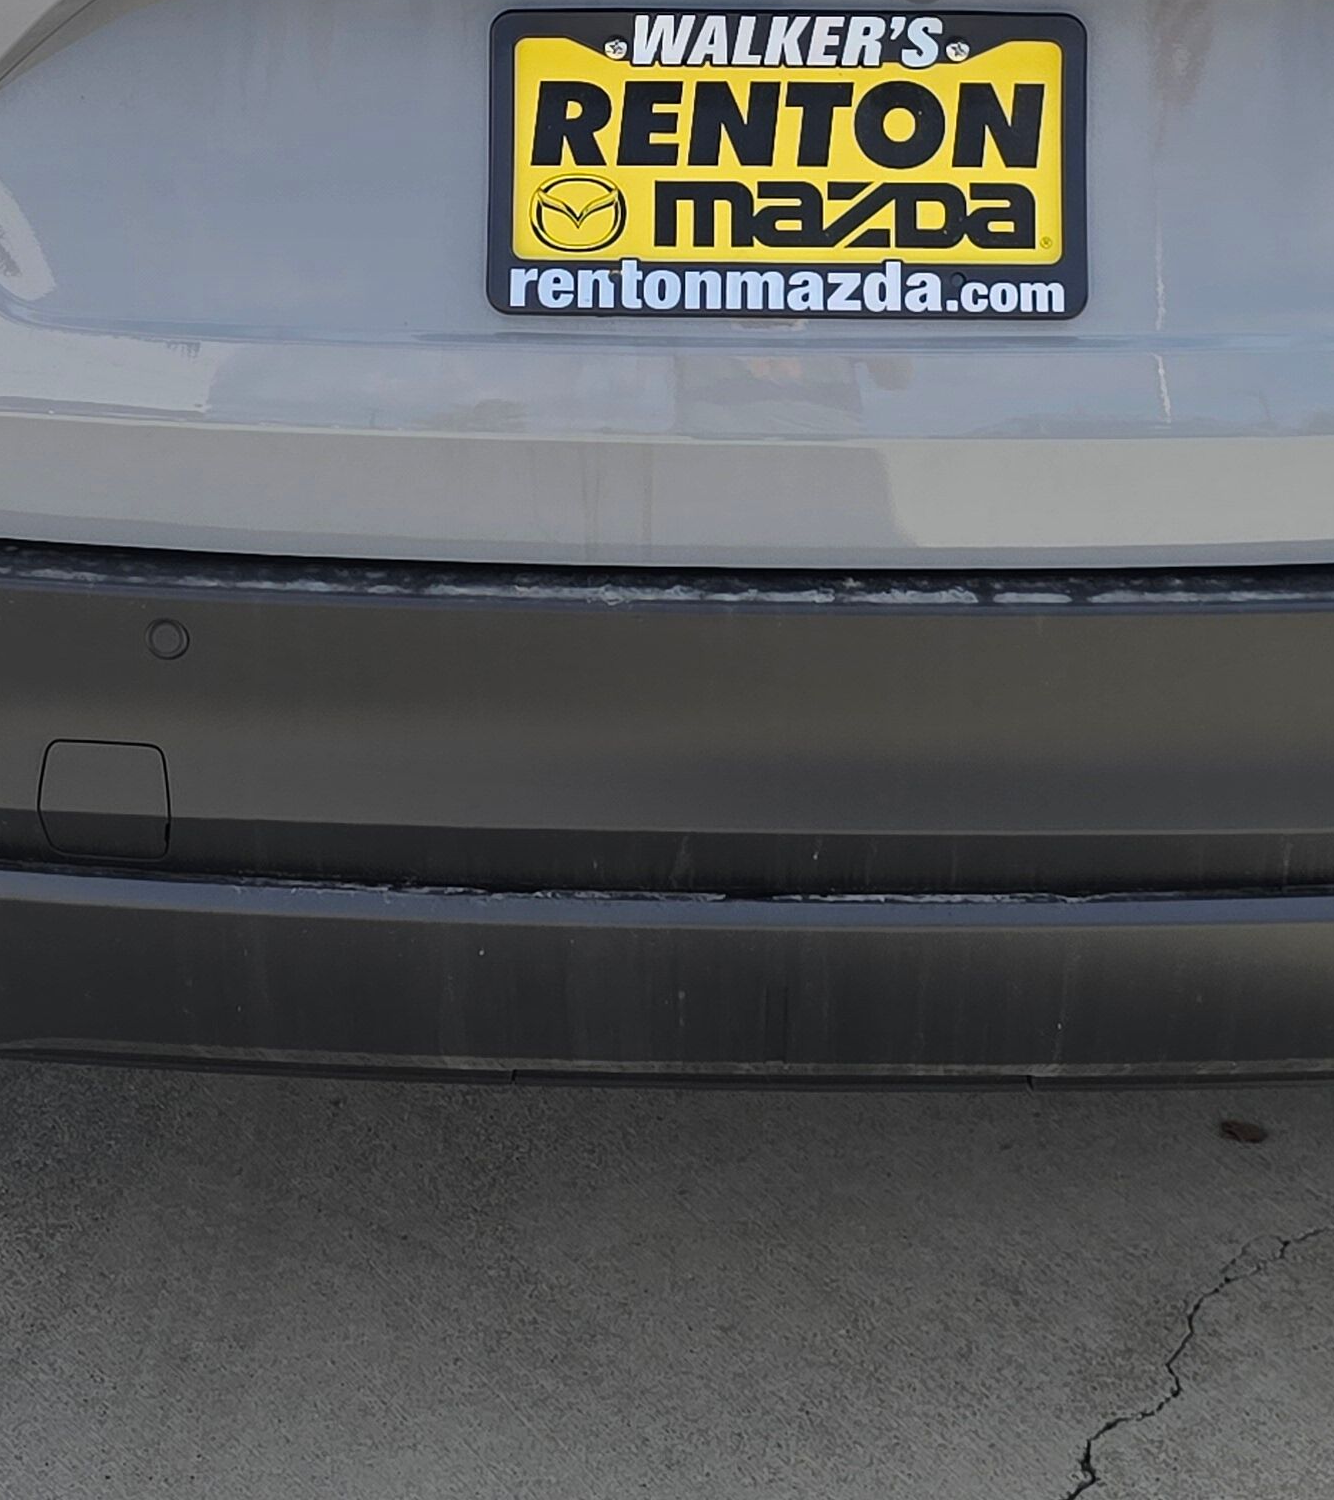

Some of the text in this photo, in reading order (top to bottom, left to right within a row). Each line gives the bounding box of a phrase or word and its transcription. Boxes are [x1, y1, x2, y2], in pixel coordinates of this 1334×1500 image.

[631, 14, 945, 68] WALKER'S
[530, 80, 1046, 170] RENTON
[509, 258, 1067, 313] rentonmazda.com
